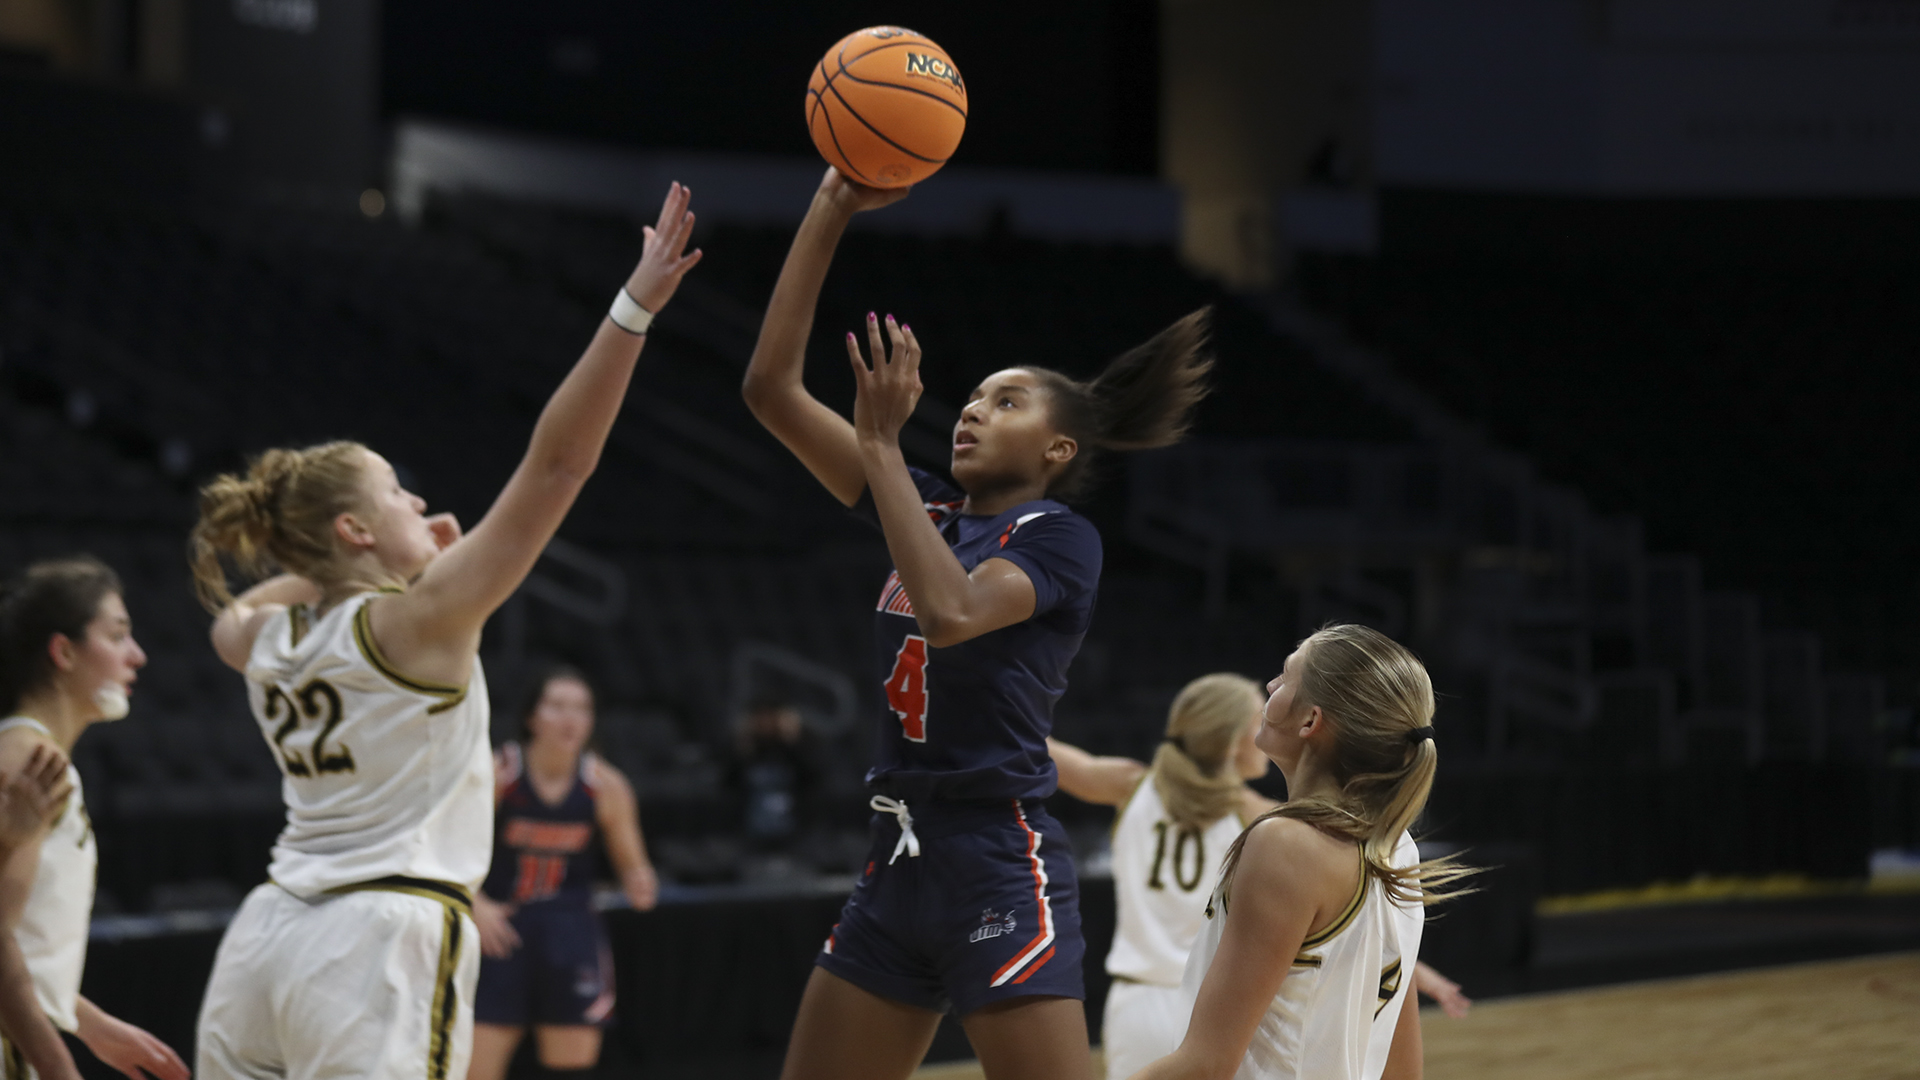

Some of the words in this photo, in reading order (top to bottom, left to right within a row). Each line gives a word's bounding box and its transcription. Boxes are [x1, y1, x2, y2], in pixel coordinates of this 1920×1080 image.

[263, 680, 355, 777] 22
[883, 634, 929, 743] 4
[1148, 821, 1204, 892] 10
